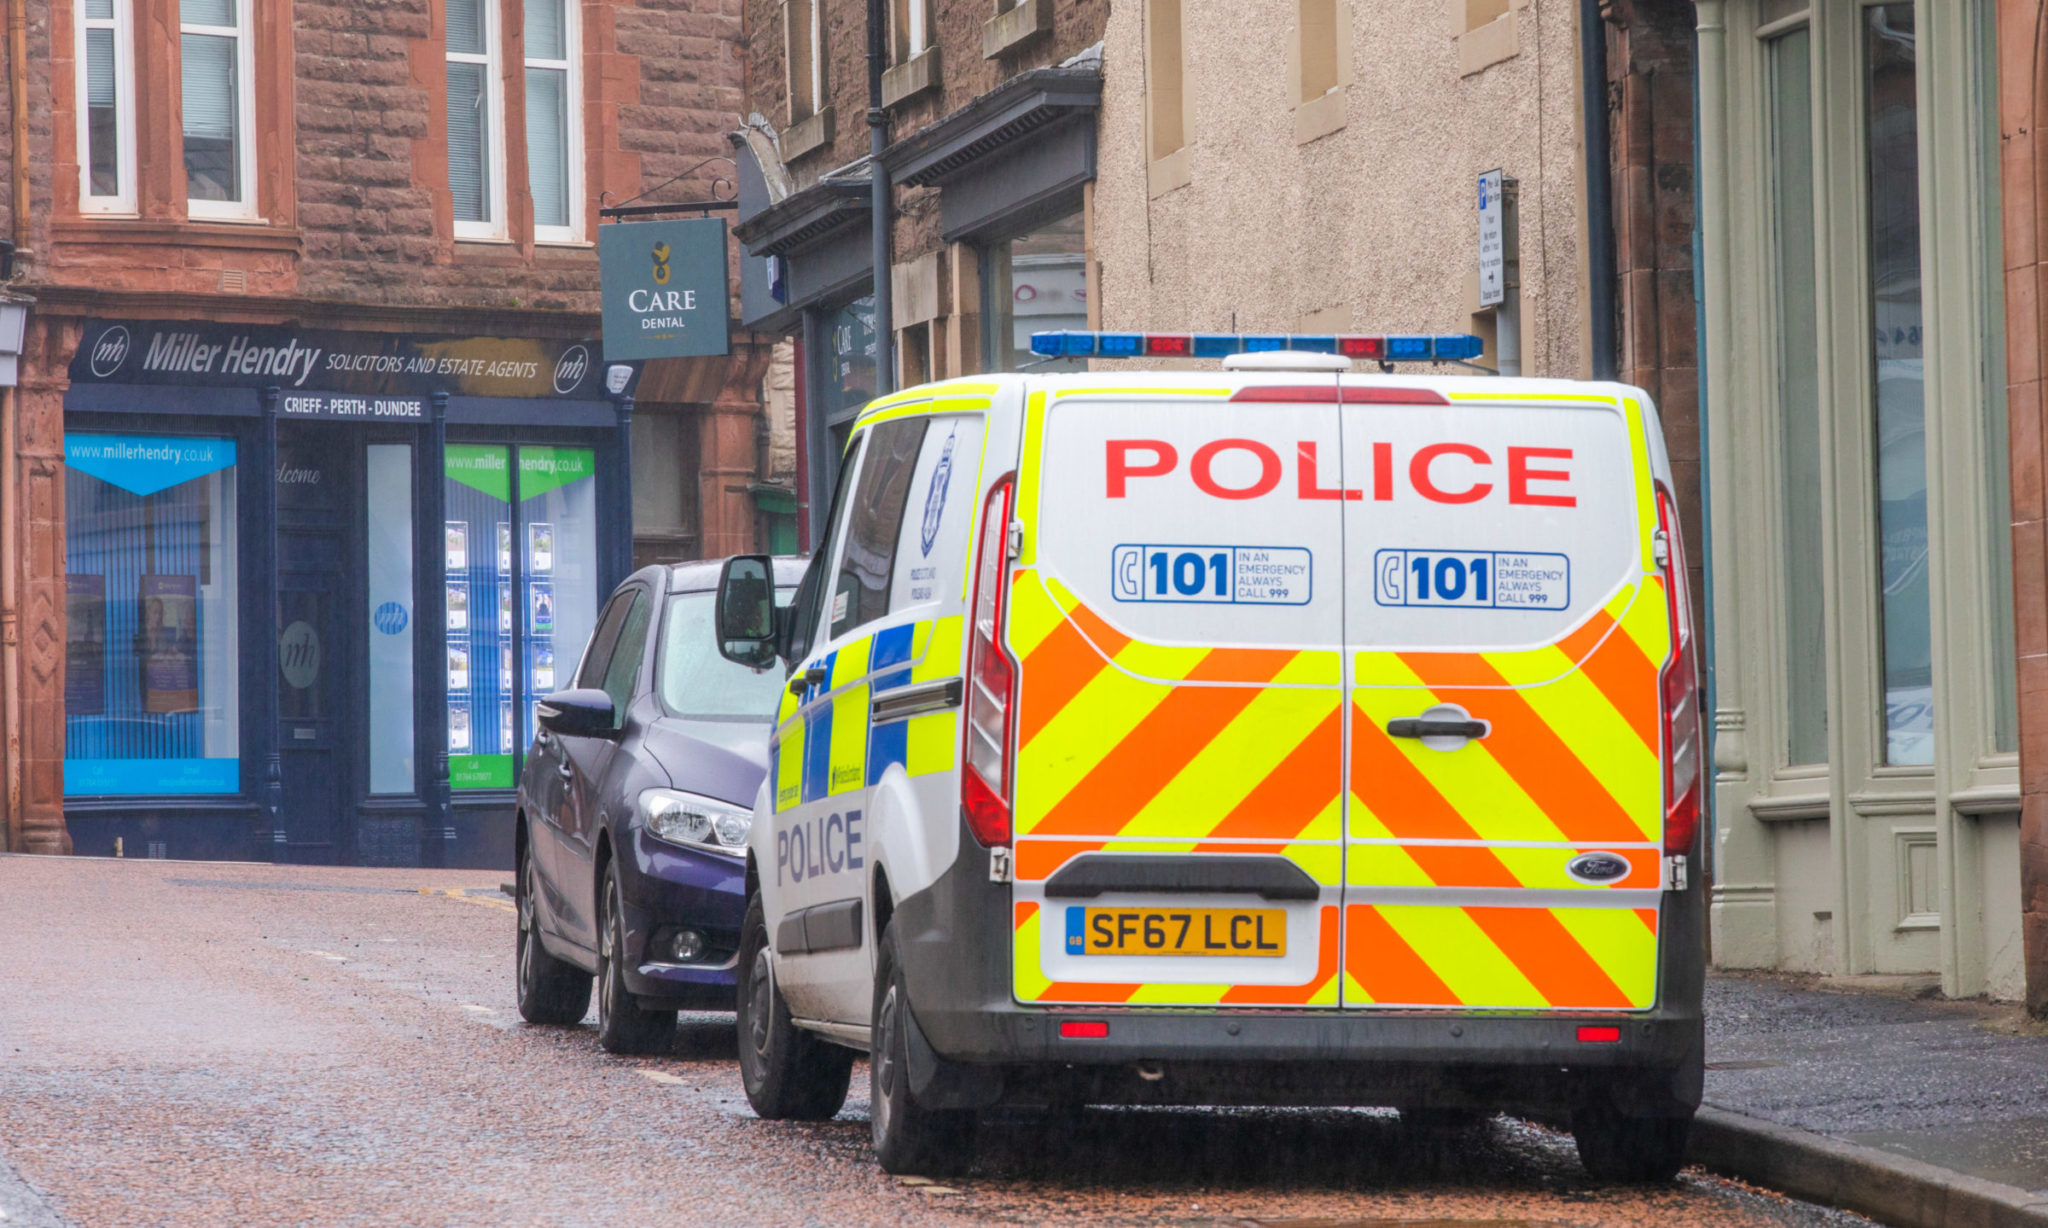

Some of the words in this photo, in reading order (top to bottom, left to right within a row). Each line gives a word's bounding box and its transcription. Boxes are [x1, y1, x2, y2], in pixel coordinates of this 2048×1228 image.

[628, 289, 697, 313] CARE
[641, 317, 685, 329] DENTAL
[143, 332, 222, 372] Miller
[220, 336, 322, 387] Hendry
[325, 353, 404, 373] SOLICITORS
[404, 358, 436, 373] AND
[437, 358, 486, 377] ESTATE
[484, 362, 538, 379] AGENTS
[284, 397, 322, 414] CRIEFF
[330, 399, 367, 415] PERTH
[374, 400, 421, 416] DUNDEE
[71, 443, 214, 465] www.millerhendry.co.uk
[1106, 438, 1577, 508] POLICE
[1238, 552, 1250, 561] IN
[1253, 552, 1269, 562] AN
[1498, 557, 1510, 567] IN
[1512, 557, 1528, 567] AN
[1150, 552, 1227, 596] 101
[1238, 564, 1306, 575] EMERGENCY
[1498, 569, 1564, 581] EMERGENCY
[1238, 576, 1283, 587] ALWAYS
[1411, 557, 1488, 601] 101
[1498, 581, 1543, 592] ALWAYS
[1238, 587, 1267, 599] CALL
[1269, 588, 1289, 598] 999
[1498, 592, 1527, 603] CALL
[1528, 593, 1548, 603] 999
[777, 810, 864, 887] POLICE
[1583, 860, 1617, 874] Ford
[1092, 913, 1192, 949] SF67
[1204, 914, 1279, 950] LCL
